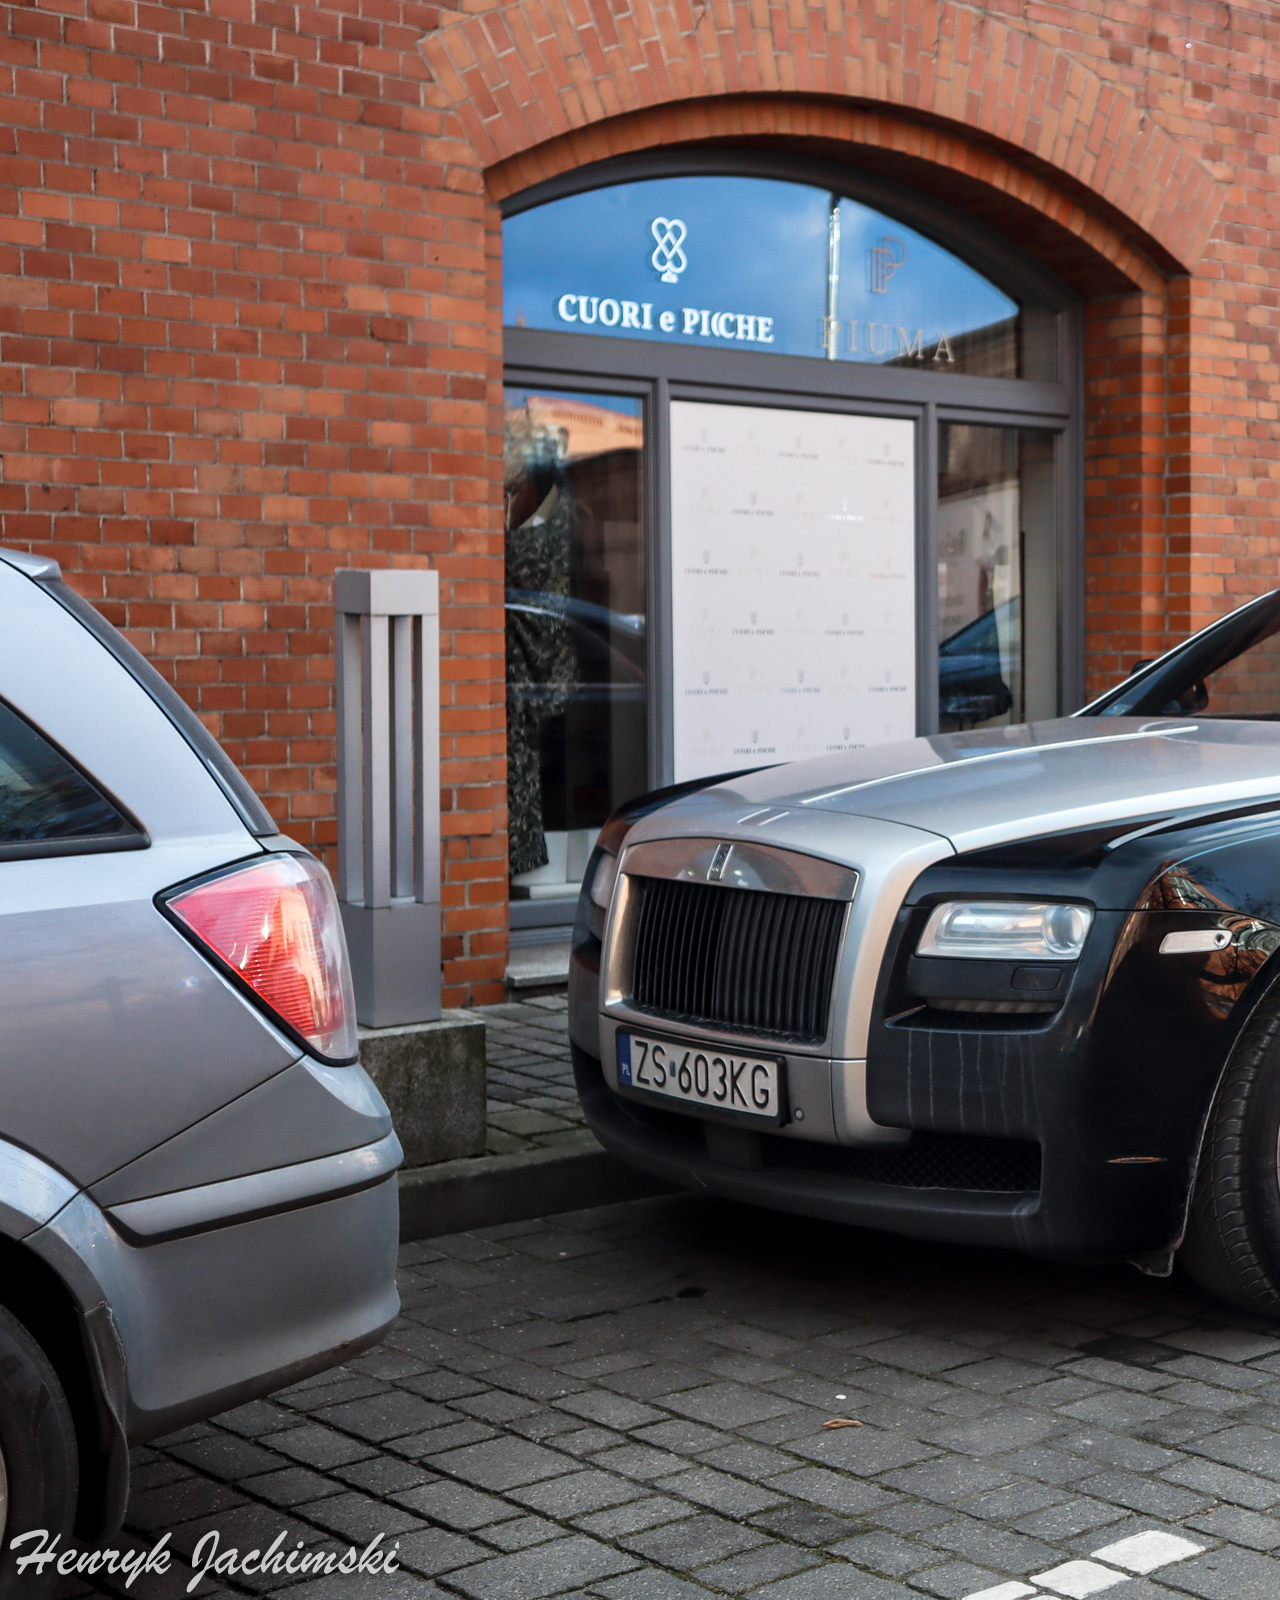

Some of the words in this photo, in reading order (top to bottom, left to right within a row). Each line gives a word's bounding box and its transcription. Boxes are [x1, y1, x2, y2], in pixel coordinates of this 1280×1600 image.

[557, 293, 654, 331] CUORI
[659, 310, 676, 333] e
[821, 316, 956, 363] PIUMA
[633, 1039, 668, 1089] ZS
[677, 1050, 770, 1110] 603KG
